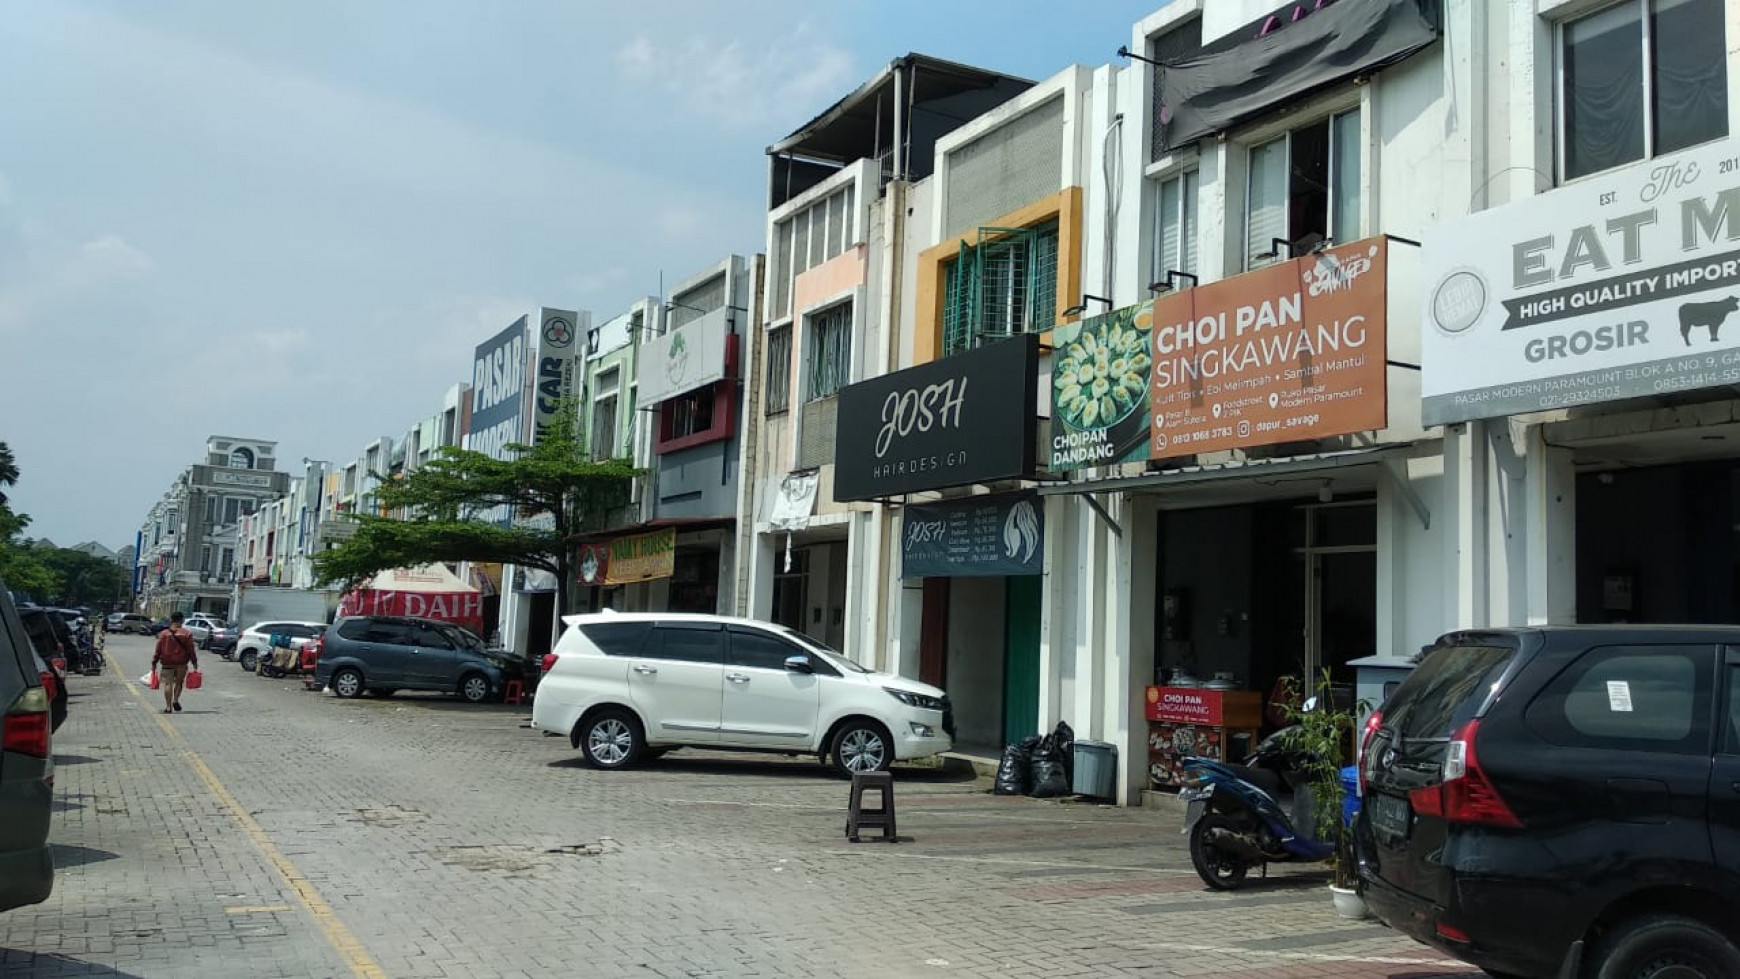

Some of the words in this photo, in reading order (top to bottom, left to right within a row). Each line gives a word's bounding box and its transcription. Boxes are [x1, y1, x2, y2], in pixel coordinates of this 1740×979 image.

[1512, 206, 1658, 290] EAT
[1520, 296, 1566, 319] HIGH
[1569, 276, 1660, 309] QUALITY
[1156, 311, 1226, 355] CHOI
[1235, 292, 1301, 337] PAN
[1524, 320, 1650, 363] GROSIR
[1156, 315, 1366, 389] SINGKAWANG
[1284, 361, 1324, 380] Sambal
[1326, 353, 1366, 372] Mantul
[472, 335, 521, 414] PASAR
[1455, 391, 1490, 405] PASAR
[1492, 384, 1541, 400] MODERN
[1544, 370, 1621, 392] PARAMOUNT
[1625, 365, 1660, 380] BLOK
[1653, 368, 1740, 391] 0853-1414-55
[875, 375, 968, 458] JOSH
[1053, 427, 1108, 450] CHOIPAN
[1053, 443, 1114, 466] DANDANG
[906, 520, 946, 552] JOSH
